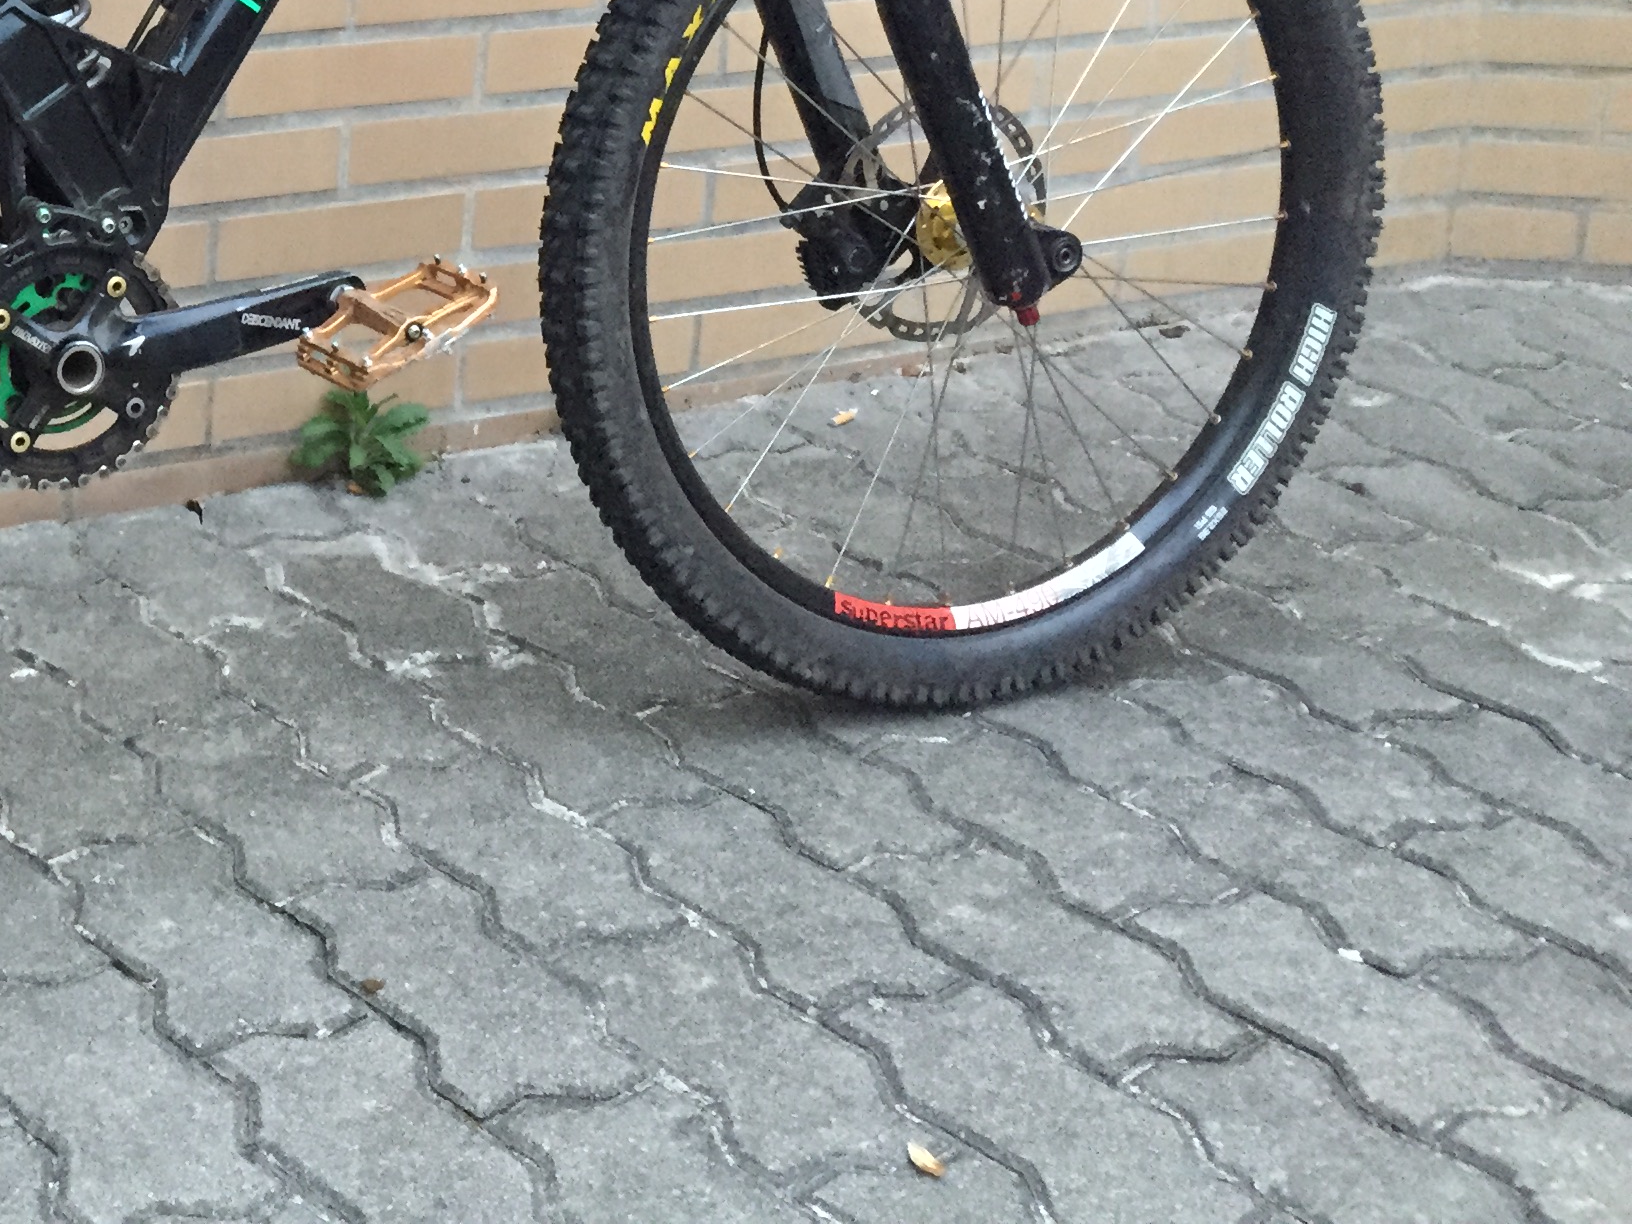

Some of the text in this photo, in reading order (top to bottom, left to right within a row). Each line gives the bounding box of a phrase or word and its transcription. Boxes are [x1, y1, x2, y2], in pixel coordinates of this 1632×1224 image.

[1227, 303, 1337, 495] HIGH ROLLER
[841, 598, 951, 631] superstar
